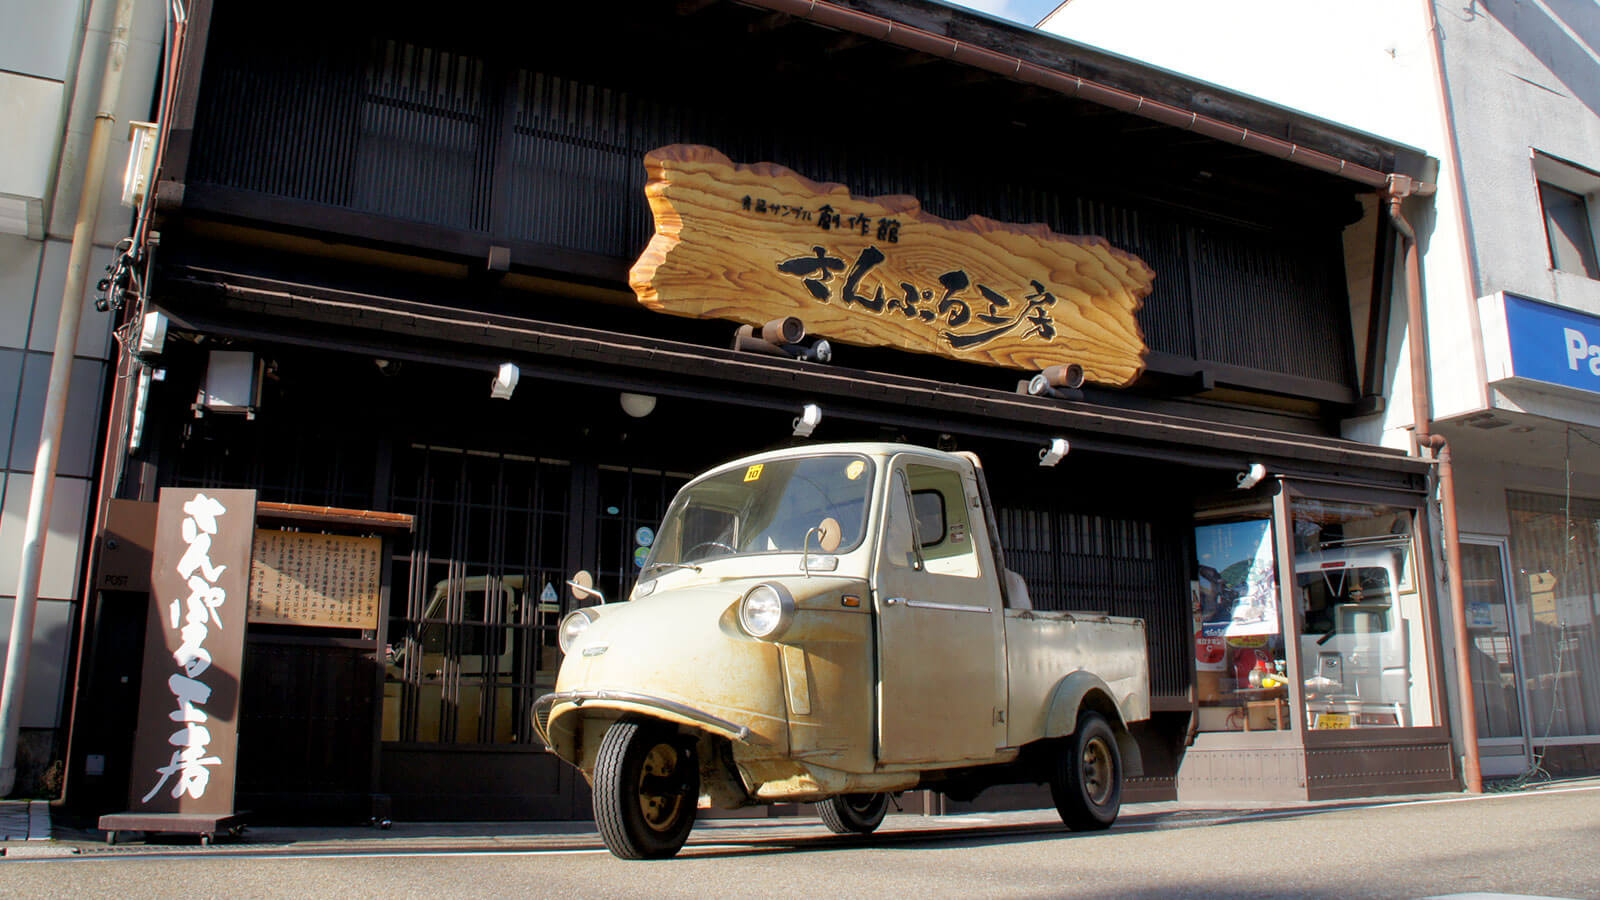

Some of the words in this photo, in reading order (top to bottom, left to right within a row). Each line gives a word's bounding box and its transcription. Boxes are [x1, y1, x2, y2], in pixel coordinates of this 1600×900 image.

[777, 246, 1058, 350] さんぷる工房
[104, 574, 129, 586] POST
